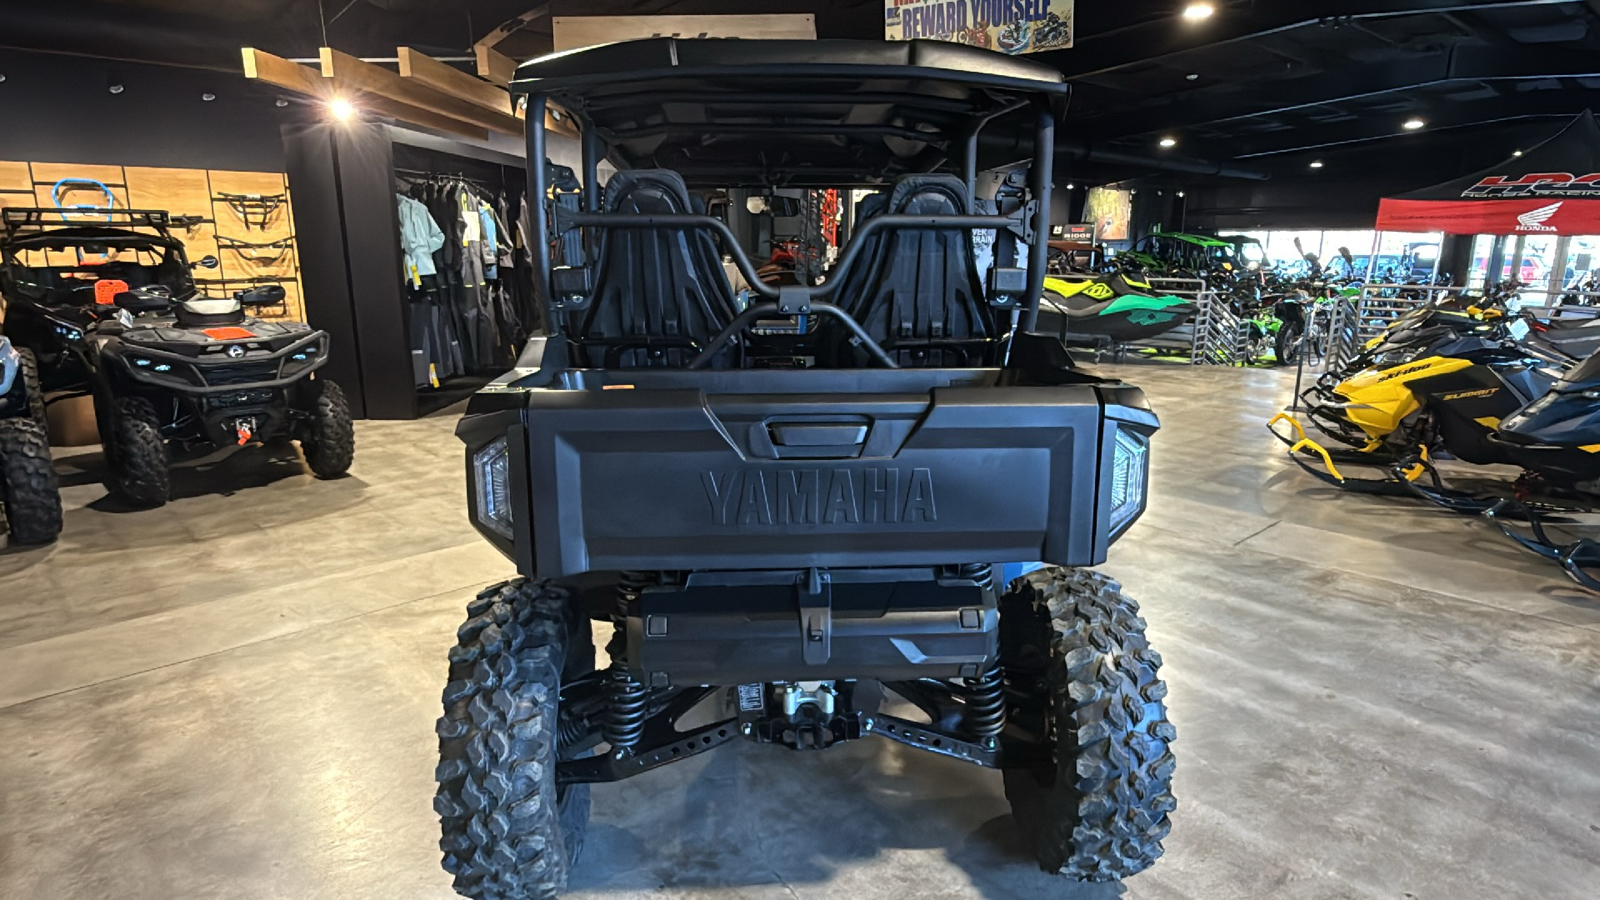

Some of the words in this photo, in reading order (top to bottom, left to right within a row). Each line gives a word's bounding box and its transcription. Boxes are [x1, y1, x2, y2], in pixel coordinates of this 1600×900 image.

[902, 0, 967, 39] REWARD
[970, 0, 1051, 29] YOURSELF
[699, 467, 938, 526] YAMAHA
